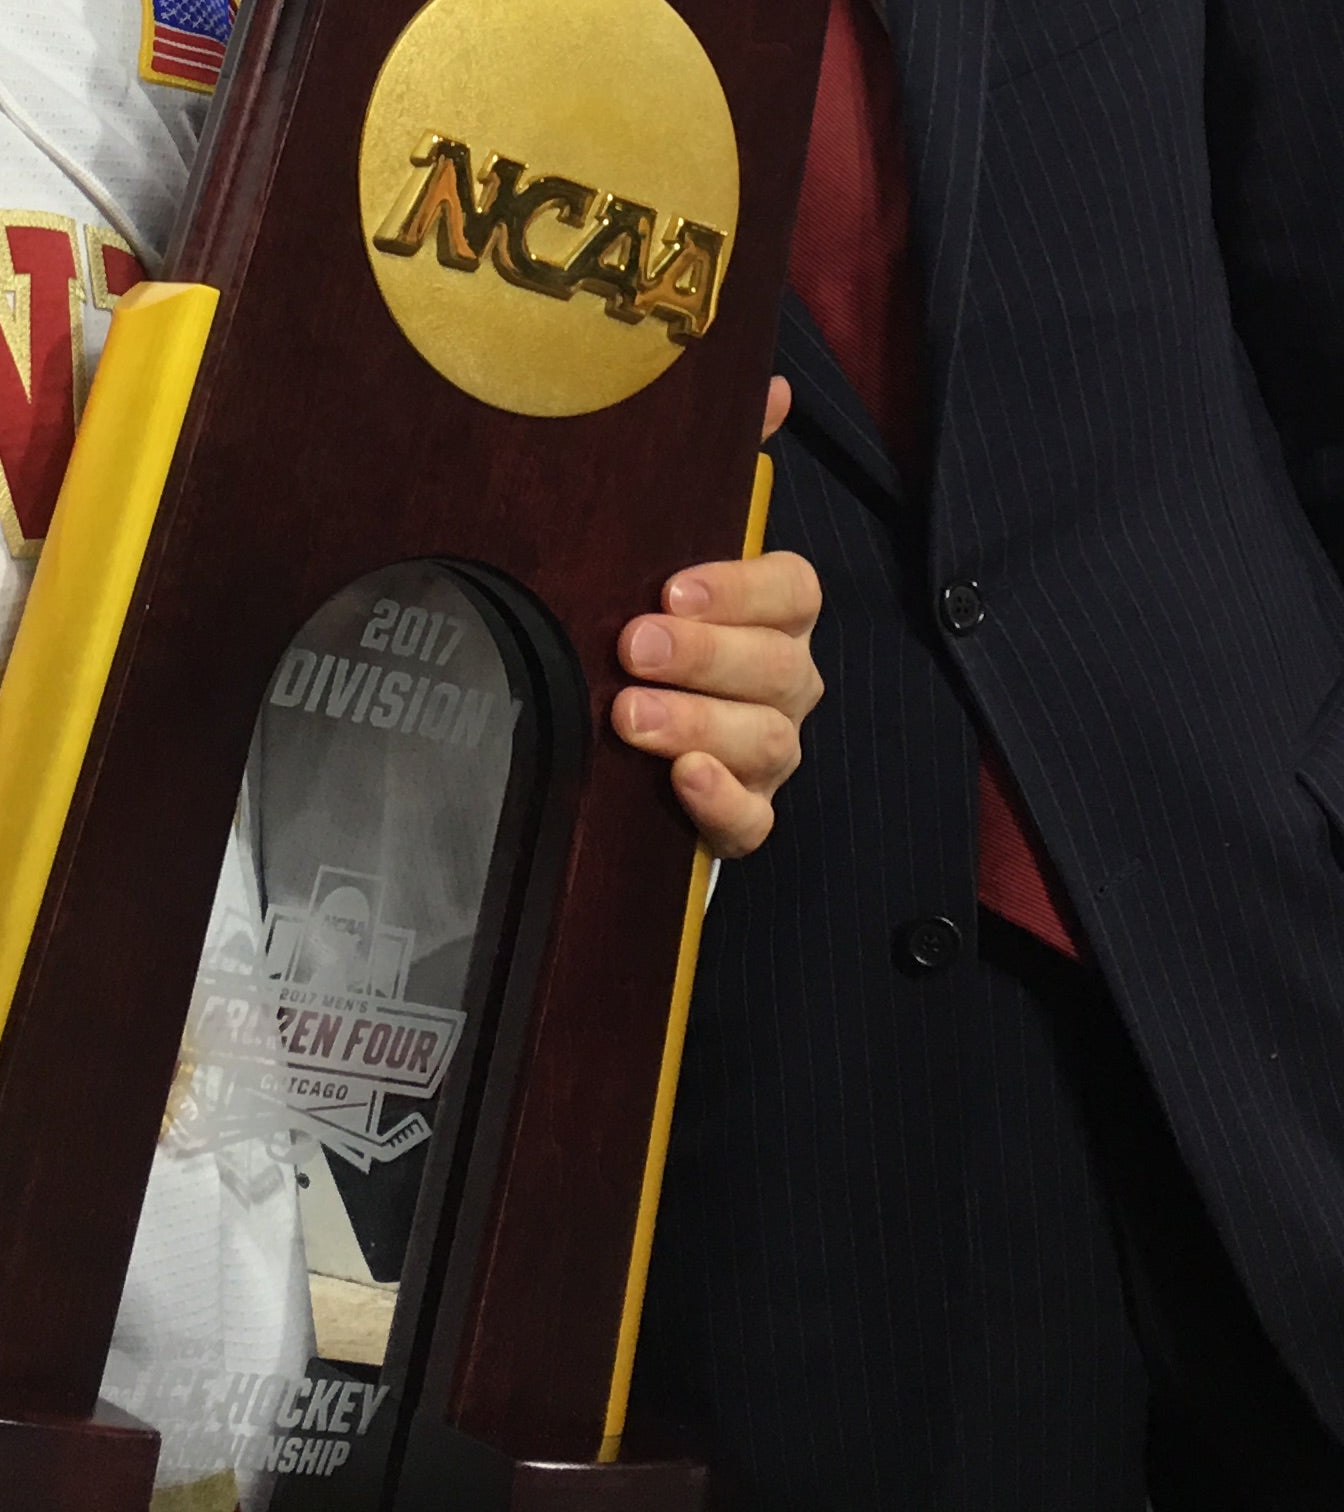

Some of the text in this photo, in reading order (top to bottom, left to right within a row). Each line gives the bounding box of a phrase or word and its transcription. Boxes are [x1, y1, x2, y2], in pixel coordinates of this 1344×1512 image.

[373, 128, 729, 346] NCAA
[359, 597, 468, 667] 2017
[269, 648, 496, 750] DIVISION
[341, 1018, 440, 1073] FOUR
